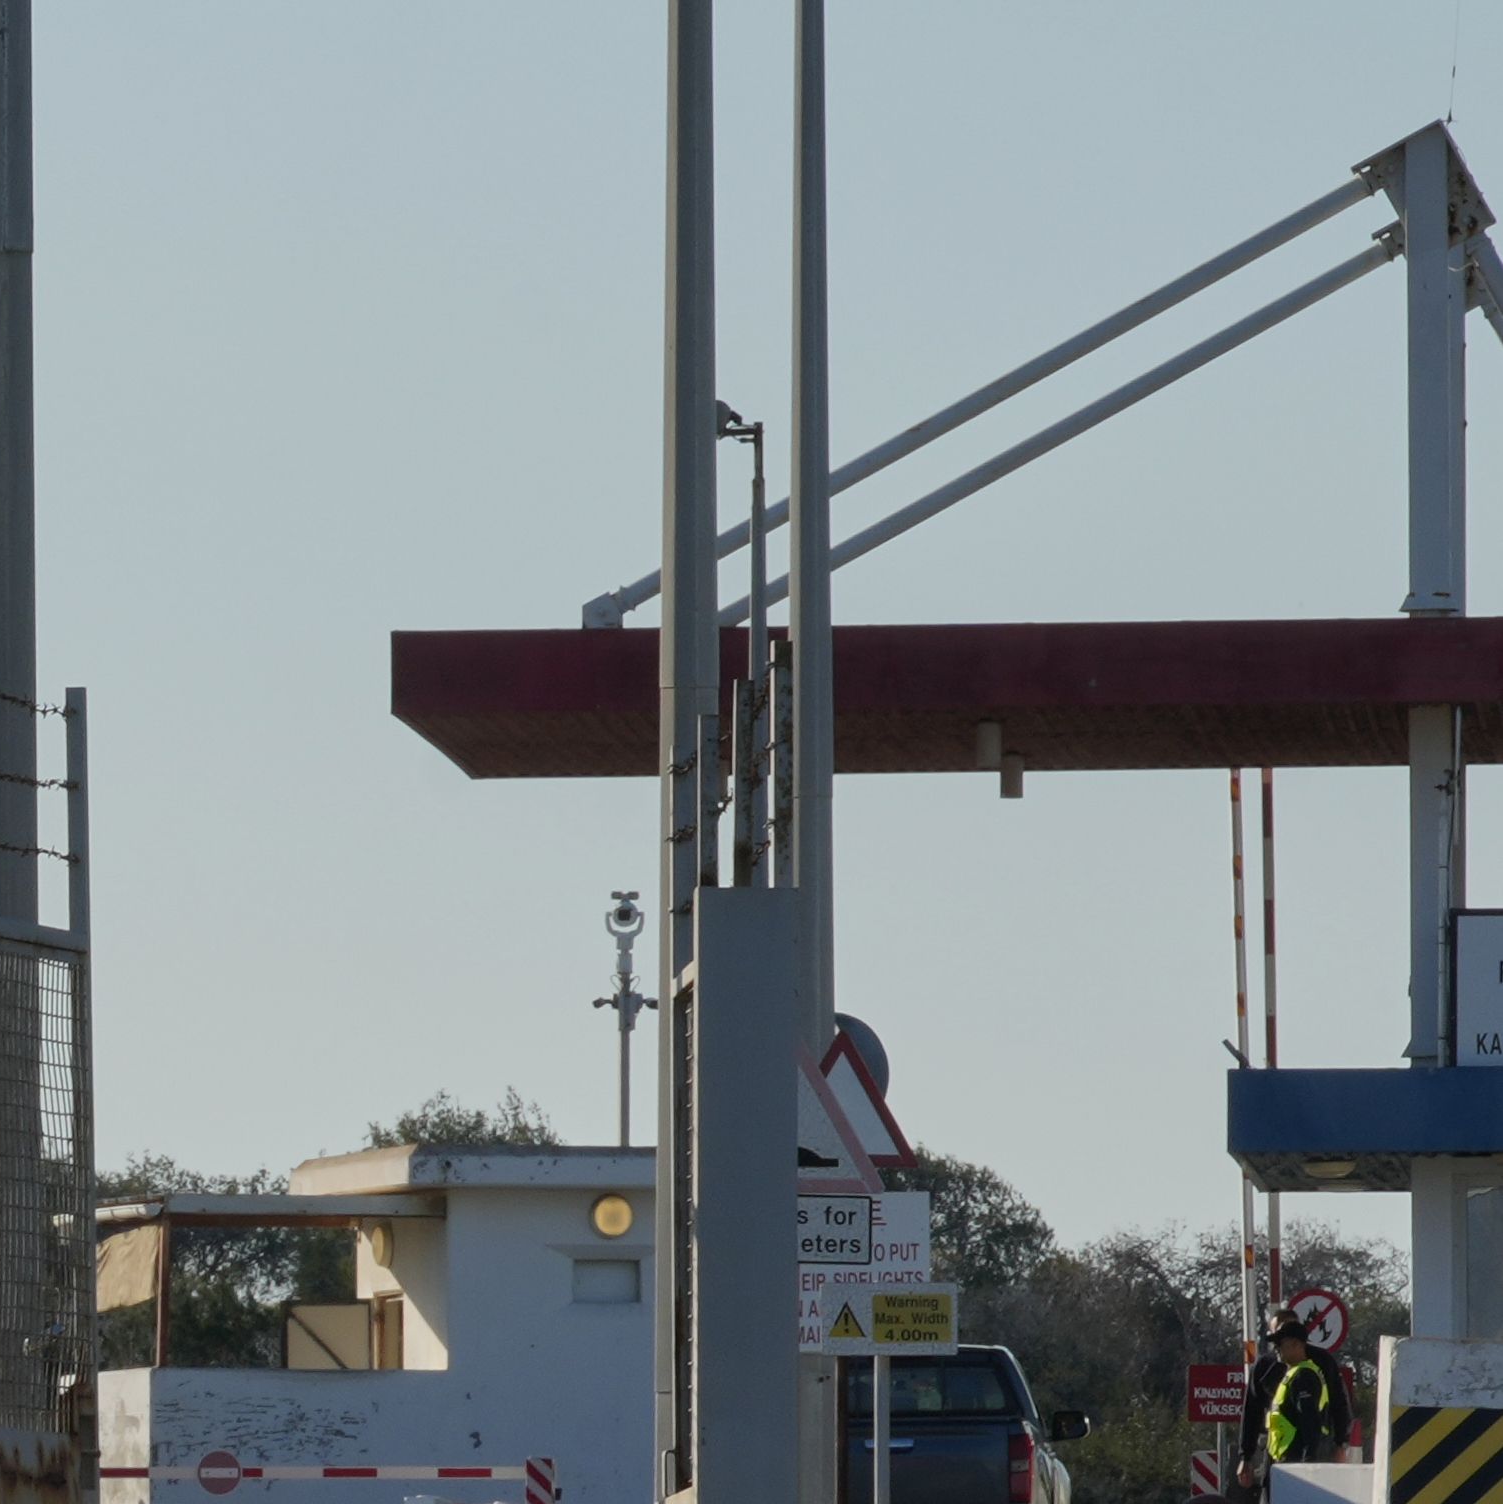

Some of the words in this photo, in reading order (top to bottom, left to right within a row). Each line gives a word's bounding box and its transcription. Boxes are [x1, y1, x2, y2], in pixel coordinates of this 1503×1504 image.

[824, 1206, 857, 1225] for
[801, 1235, 861, 1253] eters
[889, 1243, 920, 1262] PUT
[885, 1296, 939, 1310] Warning
[875, 1313, 904, 1325] Max.
[911, 1313, 949, 1325] Width
[884, 1329, 939, 1342] 4.00m
[1227, 1372, 1244, 1384] FIR
